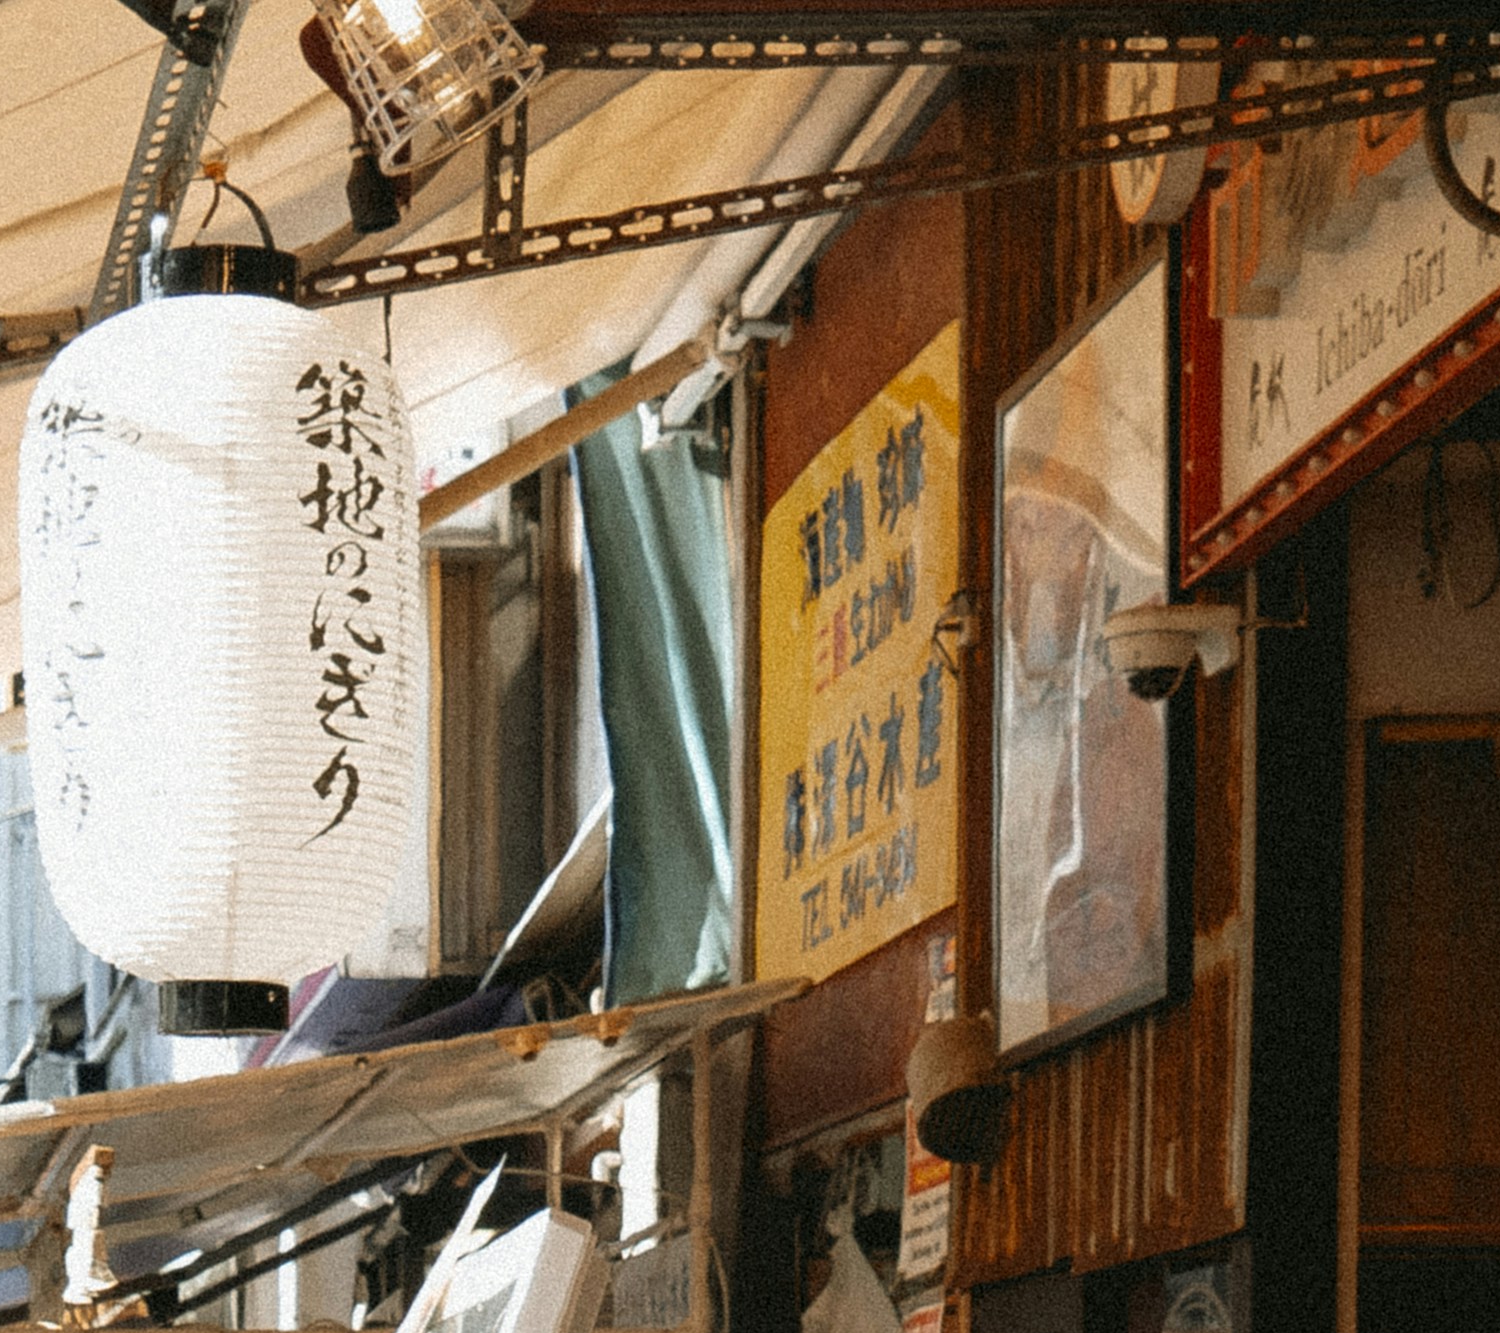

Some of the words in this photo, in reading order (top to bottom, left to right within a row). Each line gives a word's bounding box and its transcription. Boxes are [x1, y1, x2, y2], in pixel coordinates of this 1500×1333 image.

[296, 360, 387, 850] 築地のにぎり
